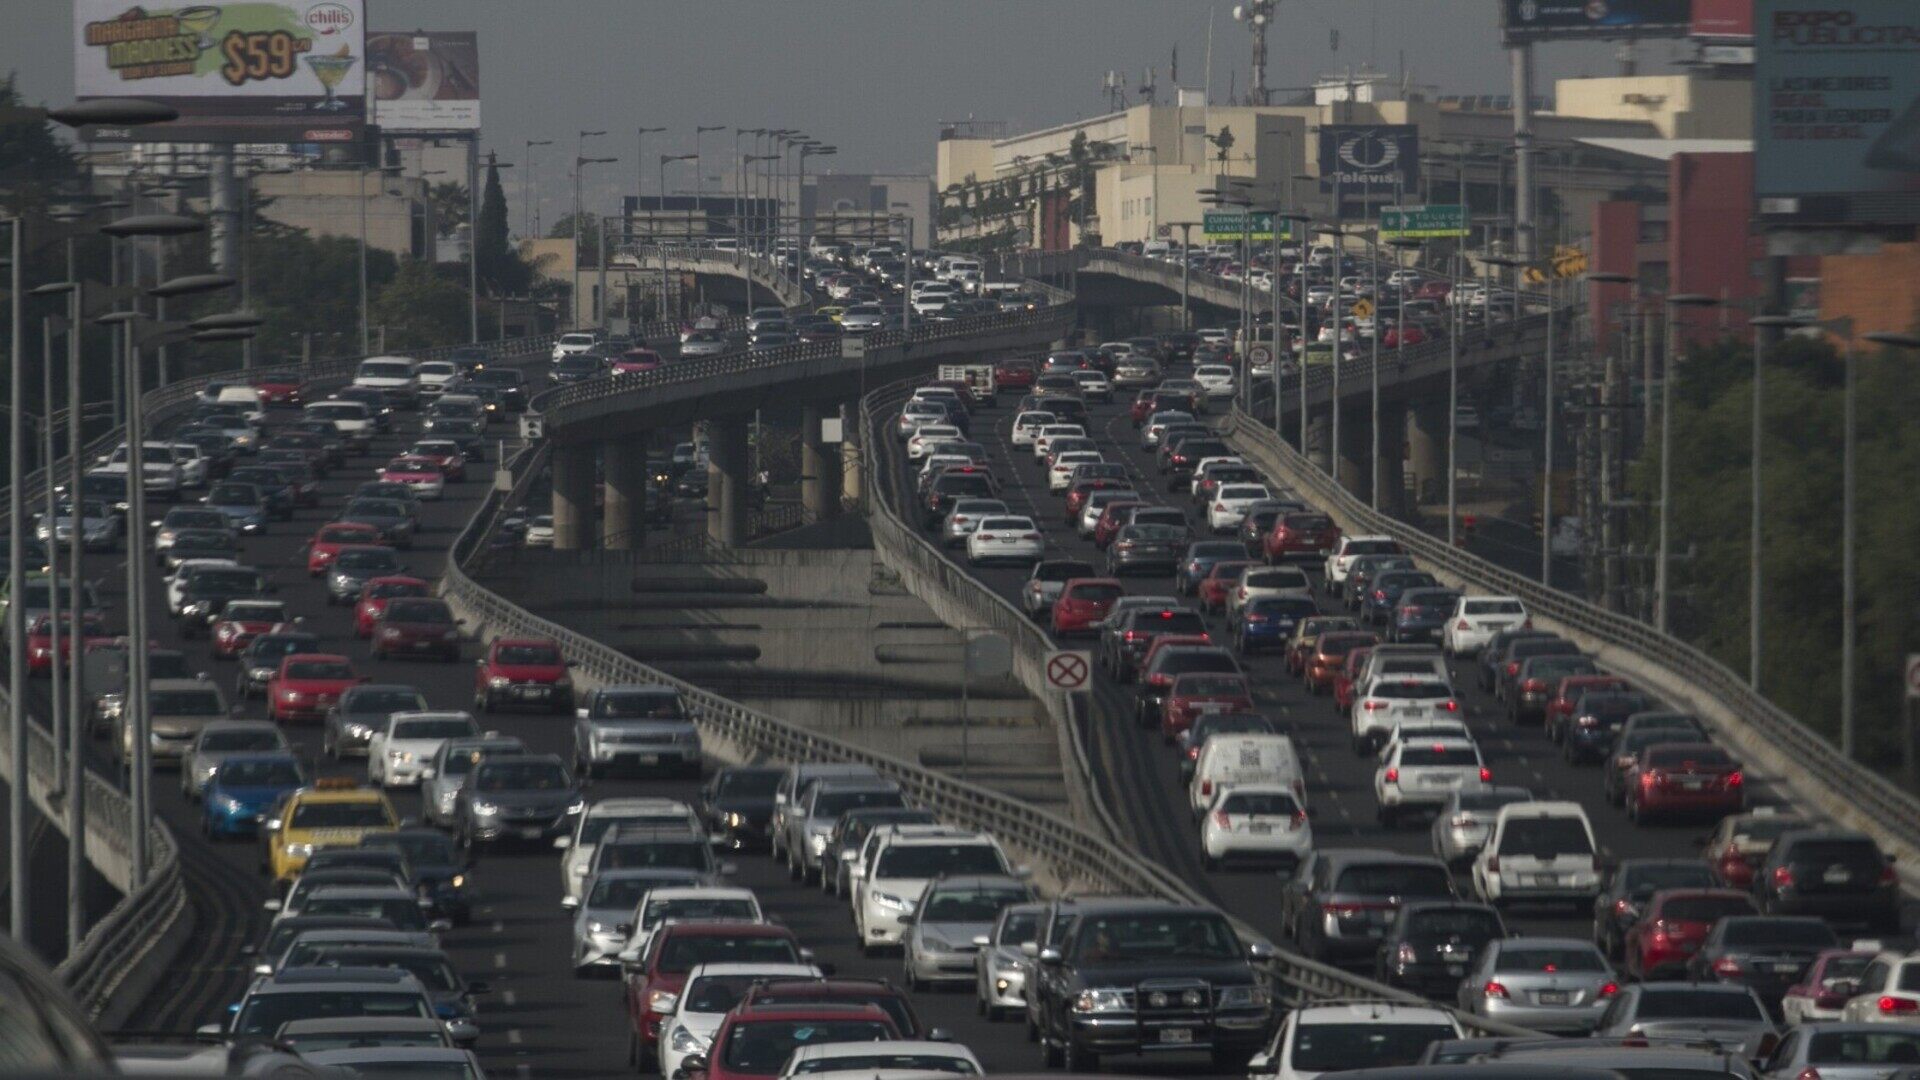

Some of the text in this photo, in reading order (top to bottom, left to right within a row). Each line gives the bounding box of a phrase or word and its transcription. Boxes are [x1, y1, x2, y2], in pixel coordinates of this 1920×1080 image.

[88, 17, 179, 43] MARGARITA
[1773, 11, 1854, 26] EXPO
[108, 35, 198, 66] MADNESS
[224, 31, 293, 83] $59
[1208, 216, 1257, 224] CUERNAVAA
